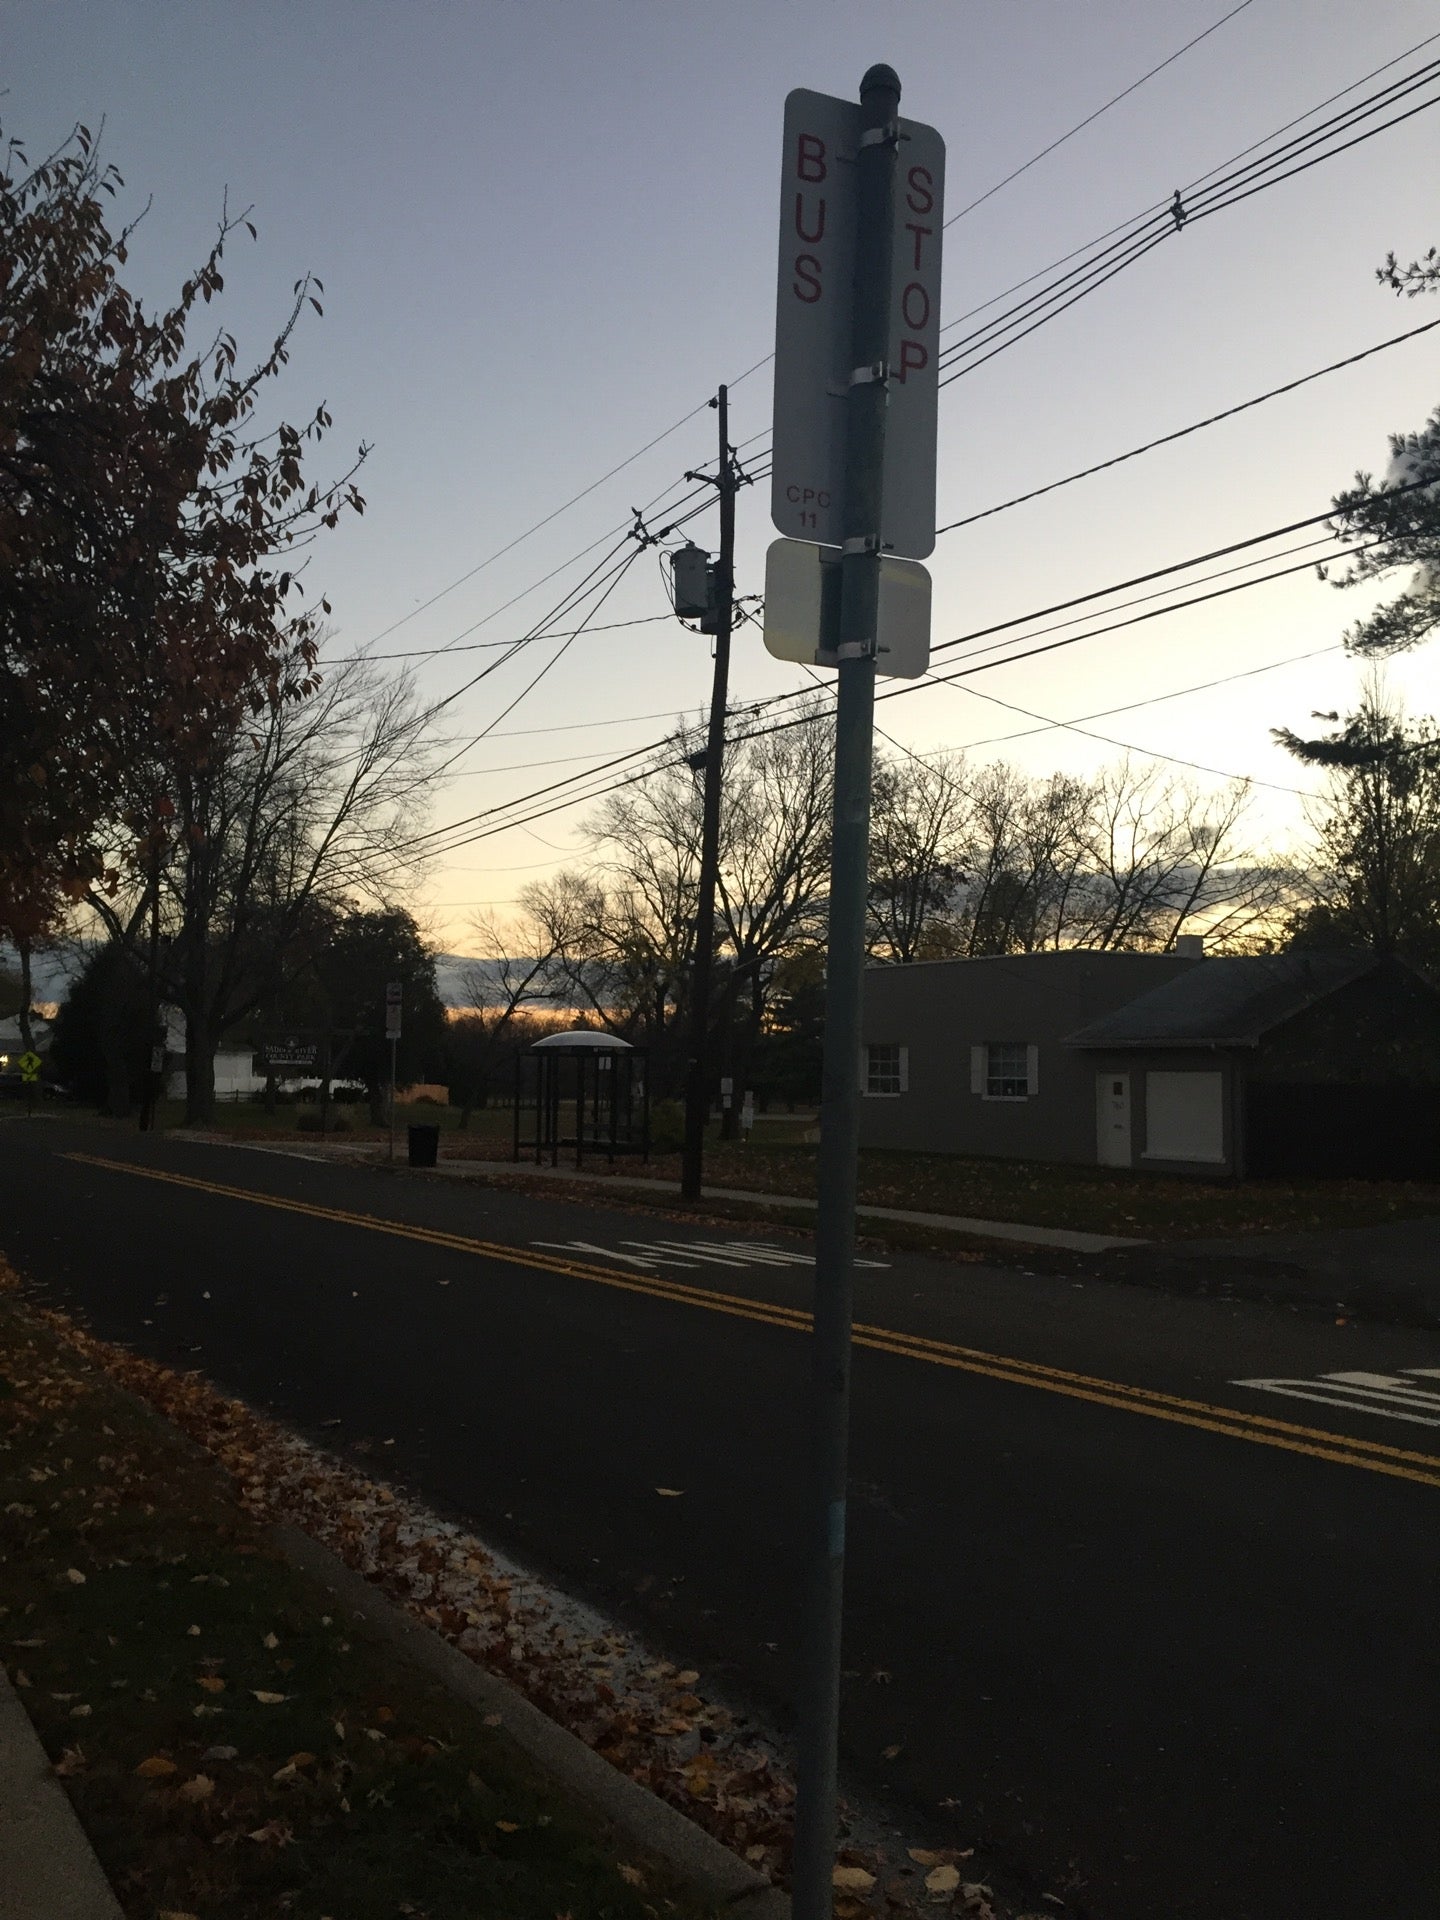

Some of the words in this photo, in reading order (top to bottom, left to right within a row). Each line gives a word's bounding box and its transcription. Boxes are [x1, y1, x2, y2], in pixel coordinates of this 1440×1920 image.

[793, 133, 827, 303] BUS
[899, 166, 934, 385] STOP
[799, 511, 817, 529] 11
